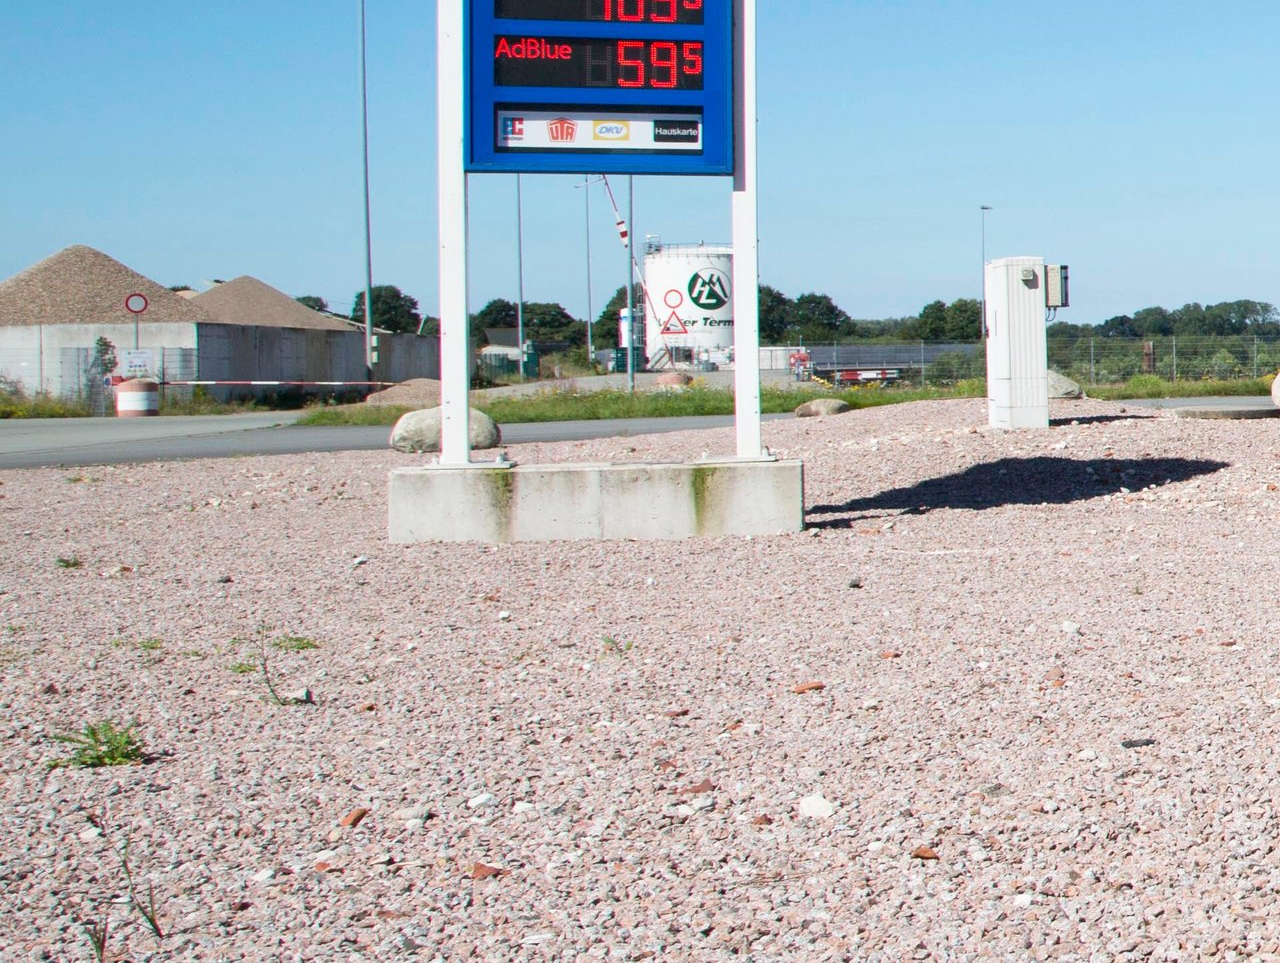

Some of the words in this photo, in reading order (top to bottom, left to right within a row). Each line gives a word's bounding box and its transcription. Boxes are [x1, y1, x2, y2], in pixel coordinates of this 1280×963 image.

[495, 37, 572, 59] AdBlue
[549, 118, 576, 141] UTA
[597, 125, 625, 135] DKV
[655, 126, 699, 137] Hauskarte
